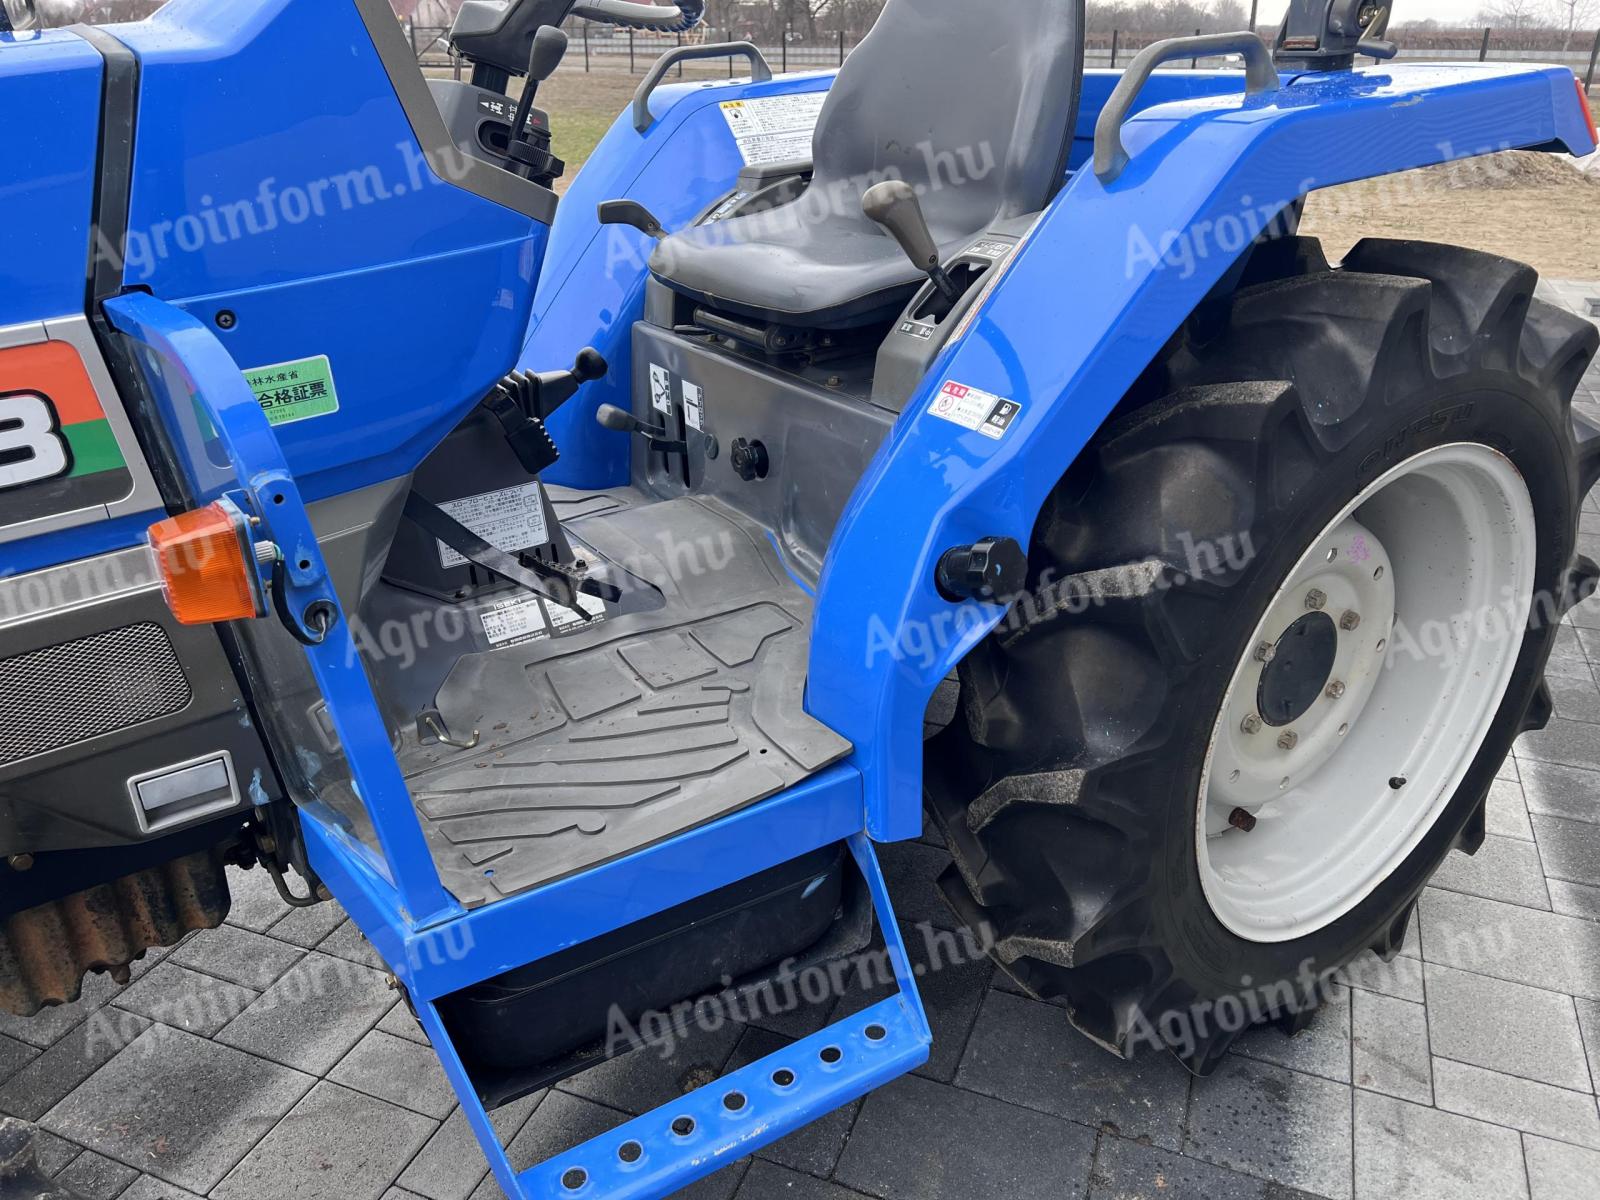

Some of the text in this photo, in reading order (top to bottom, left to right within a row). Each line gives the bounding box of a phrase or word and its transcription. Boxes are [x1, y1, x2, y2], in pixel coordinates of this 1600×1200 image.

[247, 371, 298, 386] 林水産省
[258, 381, 327, 408] 合格証票
